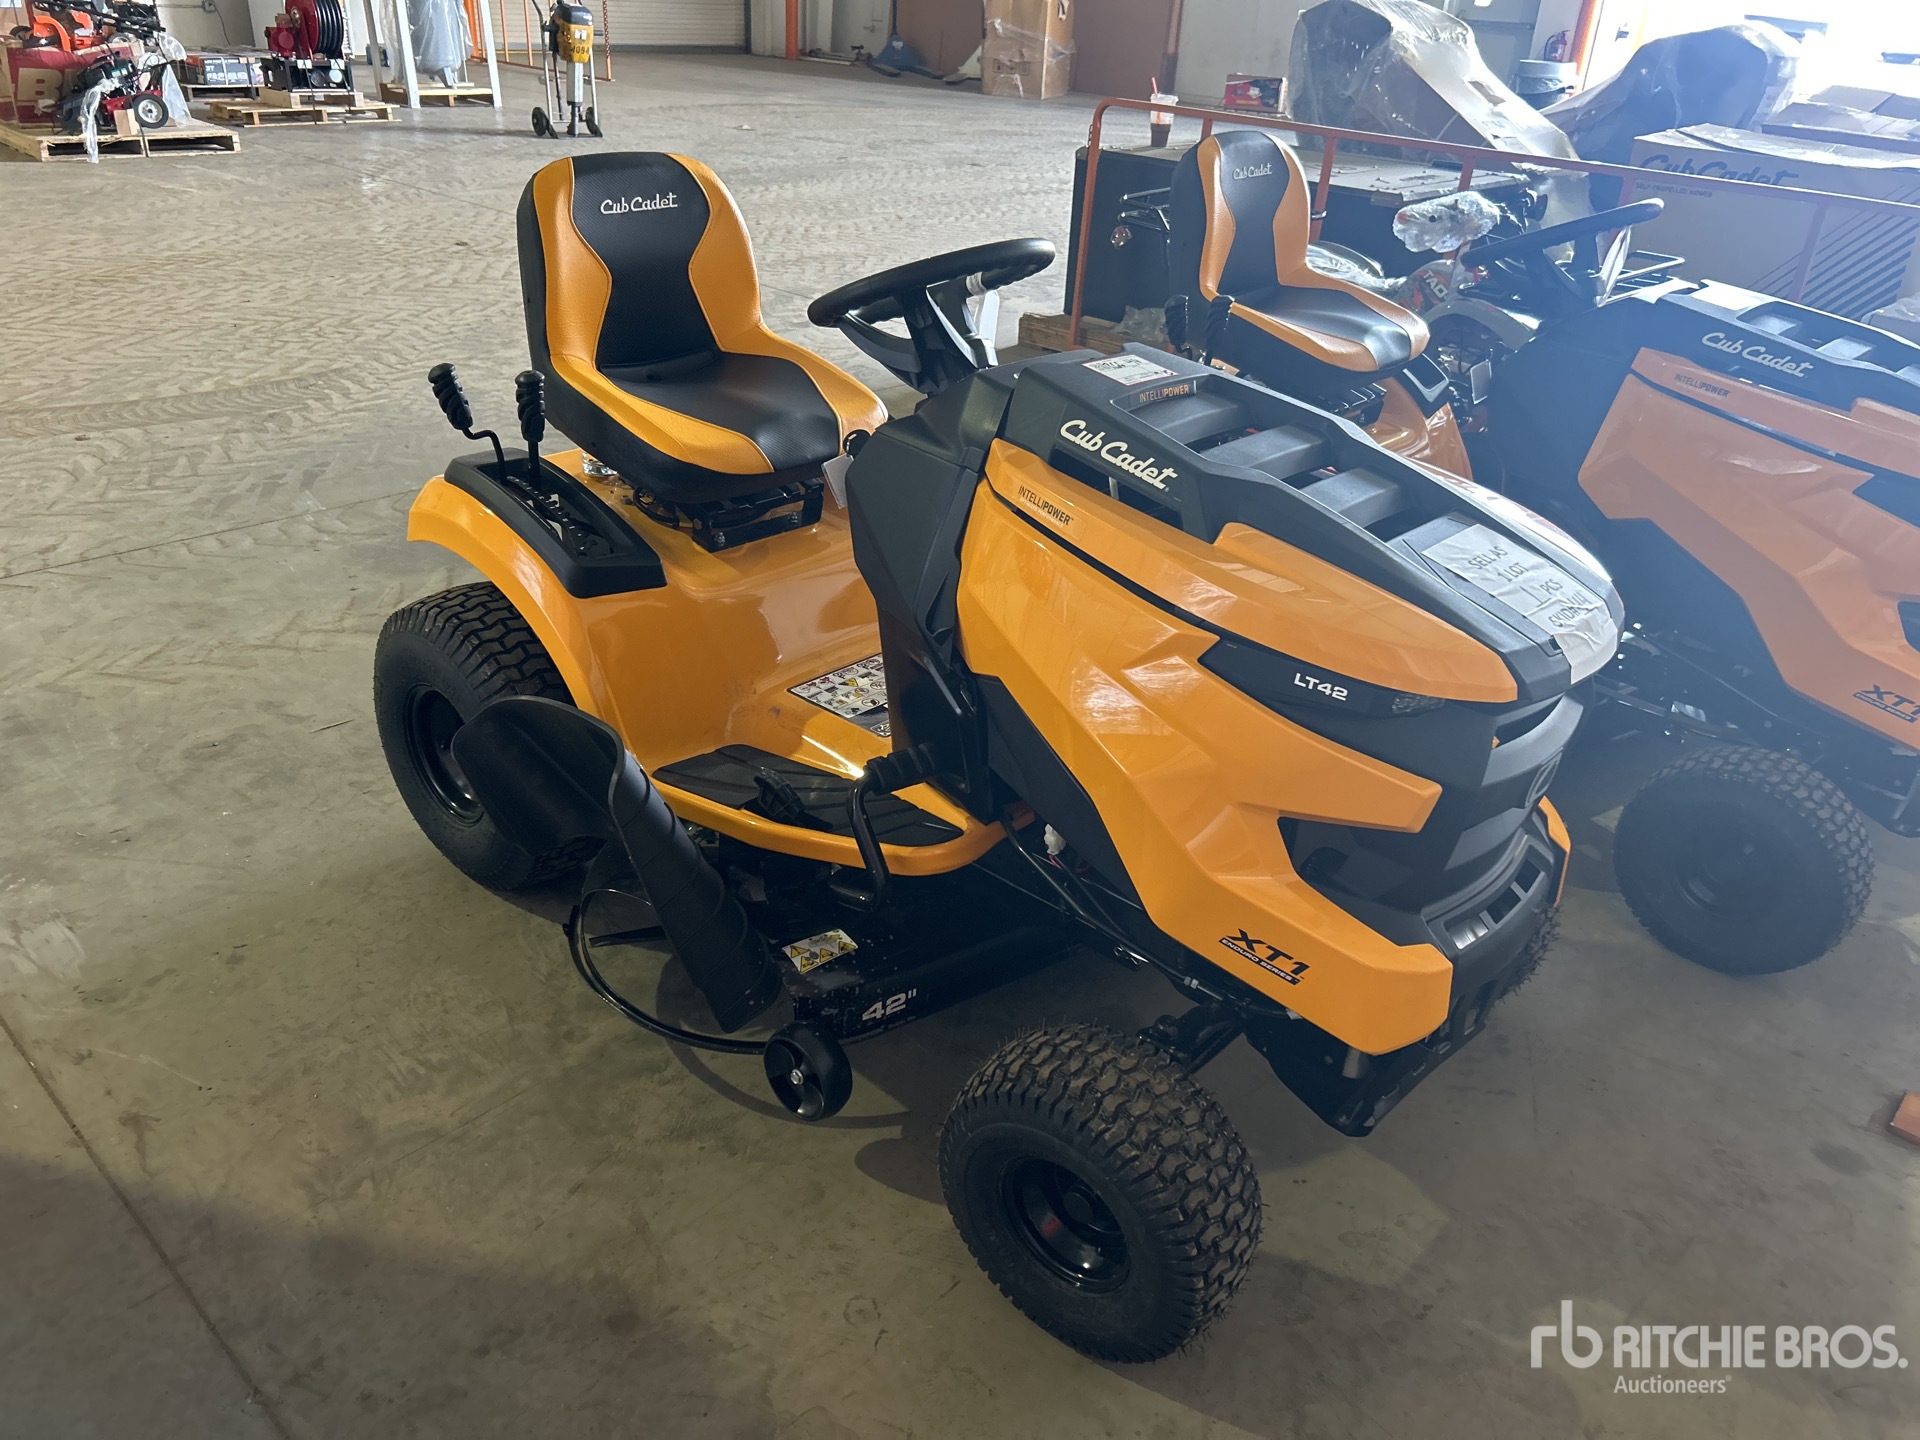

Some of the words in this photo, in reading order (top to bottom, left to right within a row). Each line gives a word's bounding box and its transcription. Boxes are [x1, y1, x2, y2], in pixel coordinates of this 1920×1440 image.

[1233, 166, 1248, 180] Cub
[1248, 162, 1273, 178] Cadet
[600, 196, 629, 214] Cub
[630, 192, 678, 211] Cadet
[1701, 332, 1743, 354] Cub
[1741, 346, 1814, 377] Cadet
[1139, 384, 1190, 403] INTELLIPOWER
[1674, 373, 1729, 398] INTELLIPOWER
[1060, 419, 1105, 452] Cub
[1100, 441, 1178, 490] Cadet
[1018, 485, 1070, 526] INTELLIPOWER
[1467, 553, 1497, 570] SELL
[1489, 545, 1509, 559] AS
[1503, 562, 1529, 578] LOT
[1539, 579, 1563, 595] PCS
[1293, 672, 1349, 702] LT42
[1221, 939, 1260, 962] ENDURO
[1259, 961, 1293, 981] SERIES
[1225, 928, 1310, 976] XT1
[862, 988, 917, 1031] 42"
